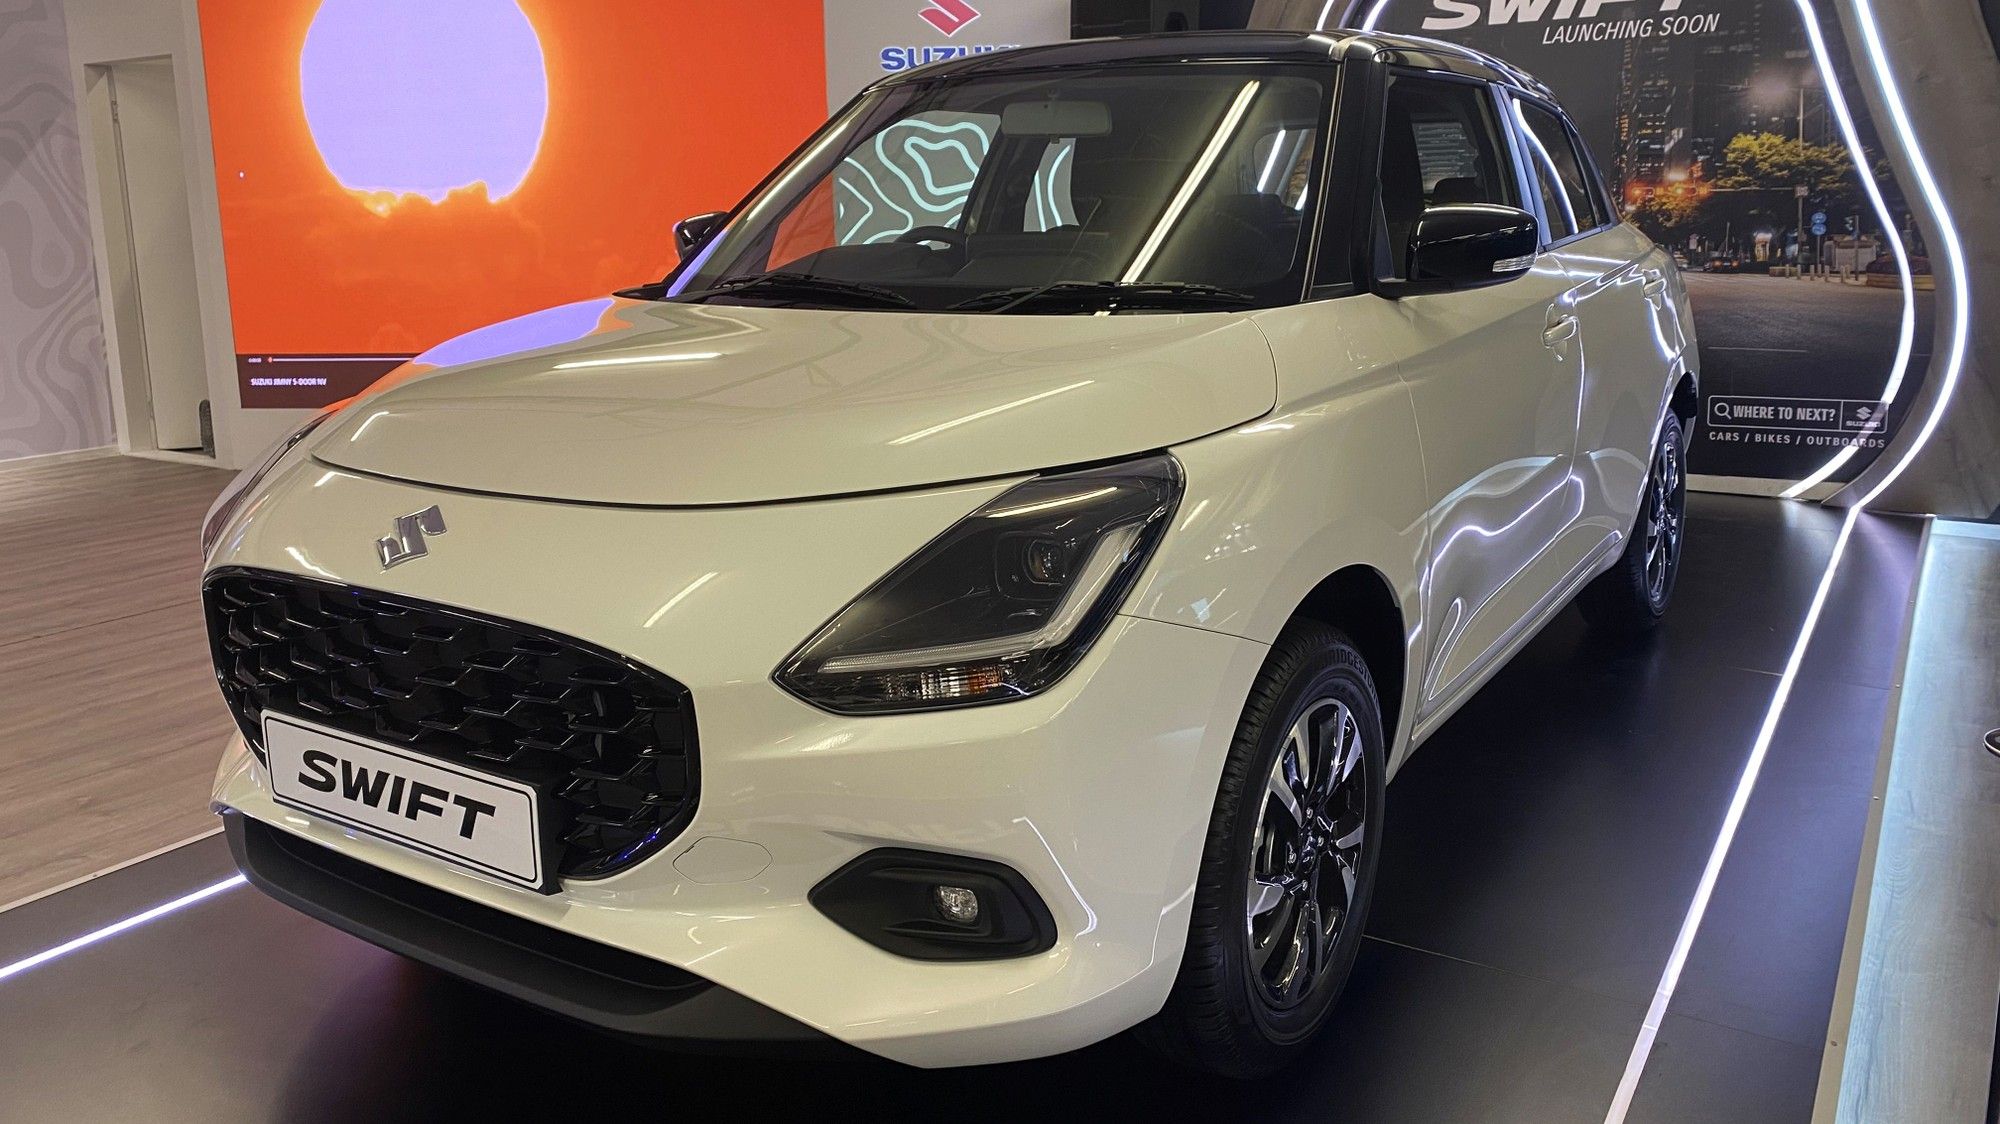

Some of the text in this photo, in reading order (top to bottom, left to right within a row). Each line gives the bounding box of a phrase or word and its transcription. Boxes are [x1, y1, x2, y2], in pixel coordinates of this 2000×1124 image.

[1542, 13, 1721, 45] LAUNCHING SOON
[879, 44, 1021, 72] SUZ
[1733, 405, 1836, 422] WHERE TO NEXT?
[1709, 431, 1740, 442] CARS
[1755, 433, 1791, 444] BIKES
[1806, 436, 1885, 449] OUTBOARDS
[298, 749, 497, 840] SWIFT
